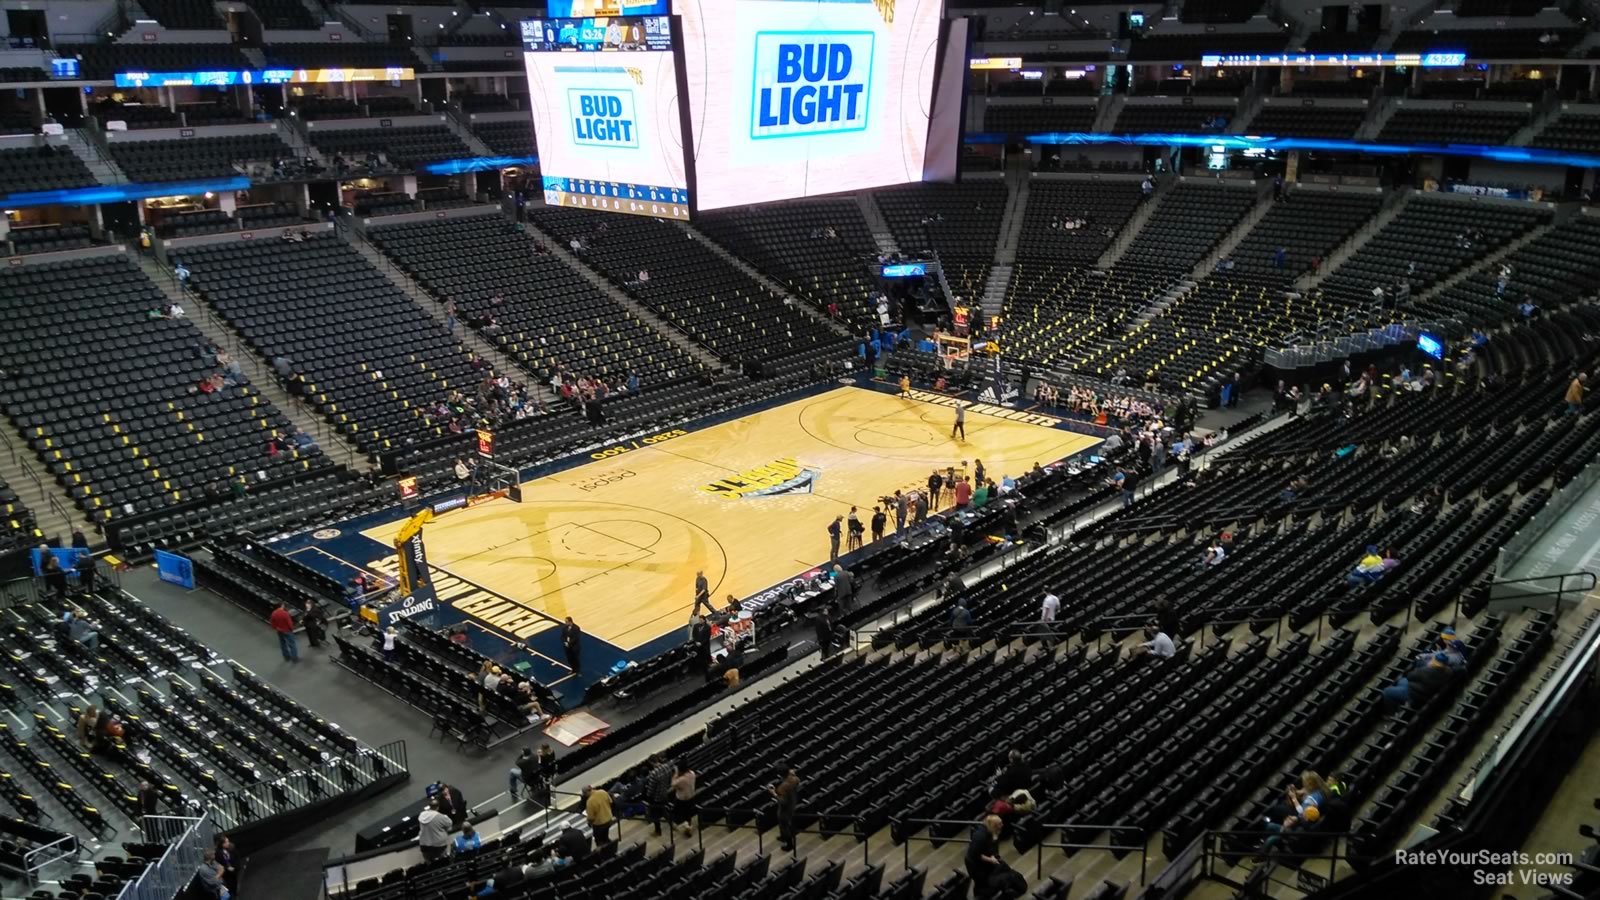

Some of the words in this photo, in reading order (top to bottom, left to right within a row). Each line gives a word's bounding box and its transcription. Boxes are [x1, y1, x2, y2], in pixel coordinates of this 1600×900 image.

[547, 29, 554, 42] 0
[632, 26, 639, 41] 0
[777, 43, 853, 83] BUD
[242, 71, 252, 84] 0
[299, 69, 307, 82] 0
[580, 95, 622, 117] BUD
[759, 83, 864, 127] LIGHT
[575, 118, 632, 142] LIGHT
[966, 403, 1062, 427] NUGGETS
[642, 429, 688, 445] 5280
[590, 446, 631, 460] 300
[579, 469, 637, 492] pepsi
[411, 534, 424, 563] xfinity
[388, 598, 434, 624] SPALDING
[451, 590, 560, 640] DENVER
